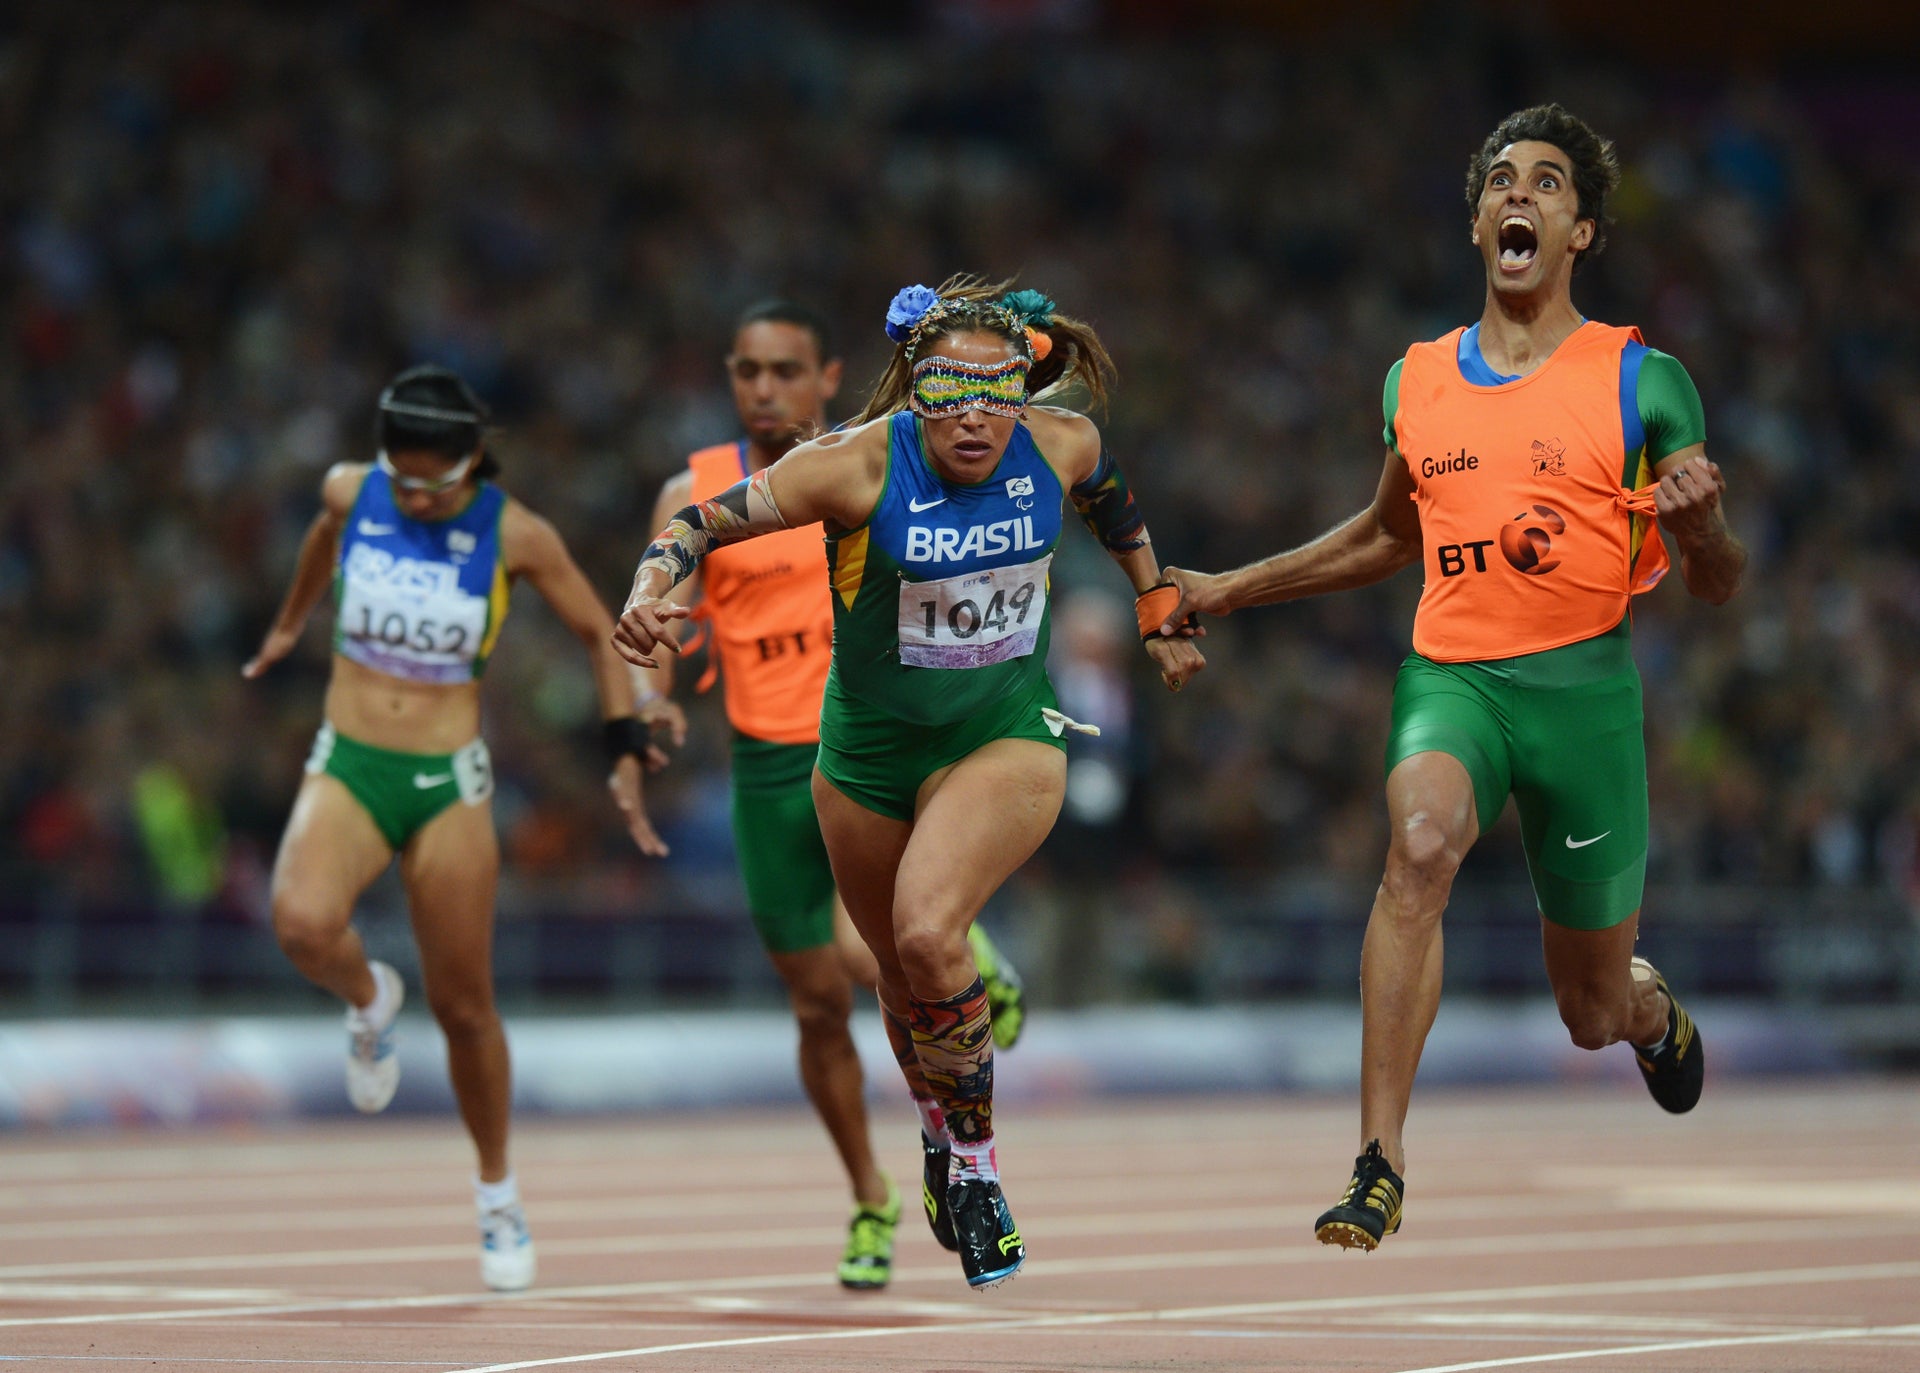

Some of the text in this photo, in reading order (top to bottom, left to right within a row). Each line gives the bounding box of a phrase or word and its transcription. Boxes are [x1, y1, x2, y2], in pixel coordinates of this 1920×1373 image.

[1421, 448, 1479, 478] Guide
[905, 515, 1045, 562] BRASIL
[1437, 539, 1495, 577] BT
[361, 606, 467, 653] 1052
[920, 581, 1035, 639] 1049
